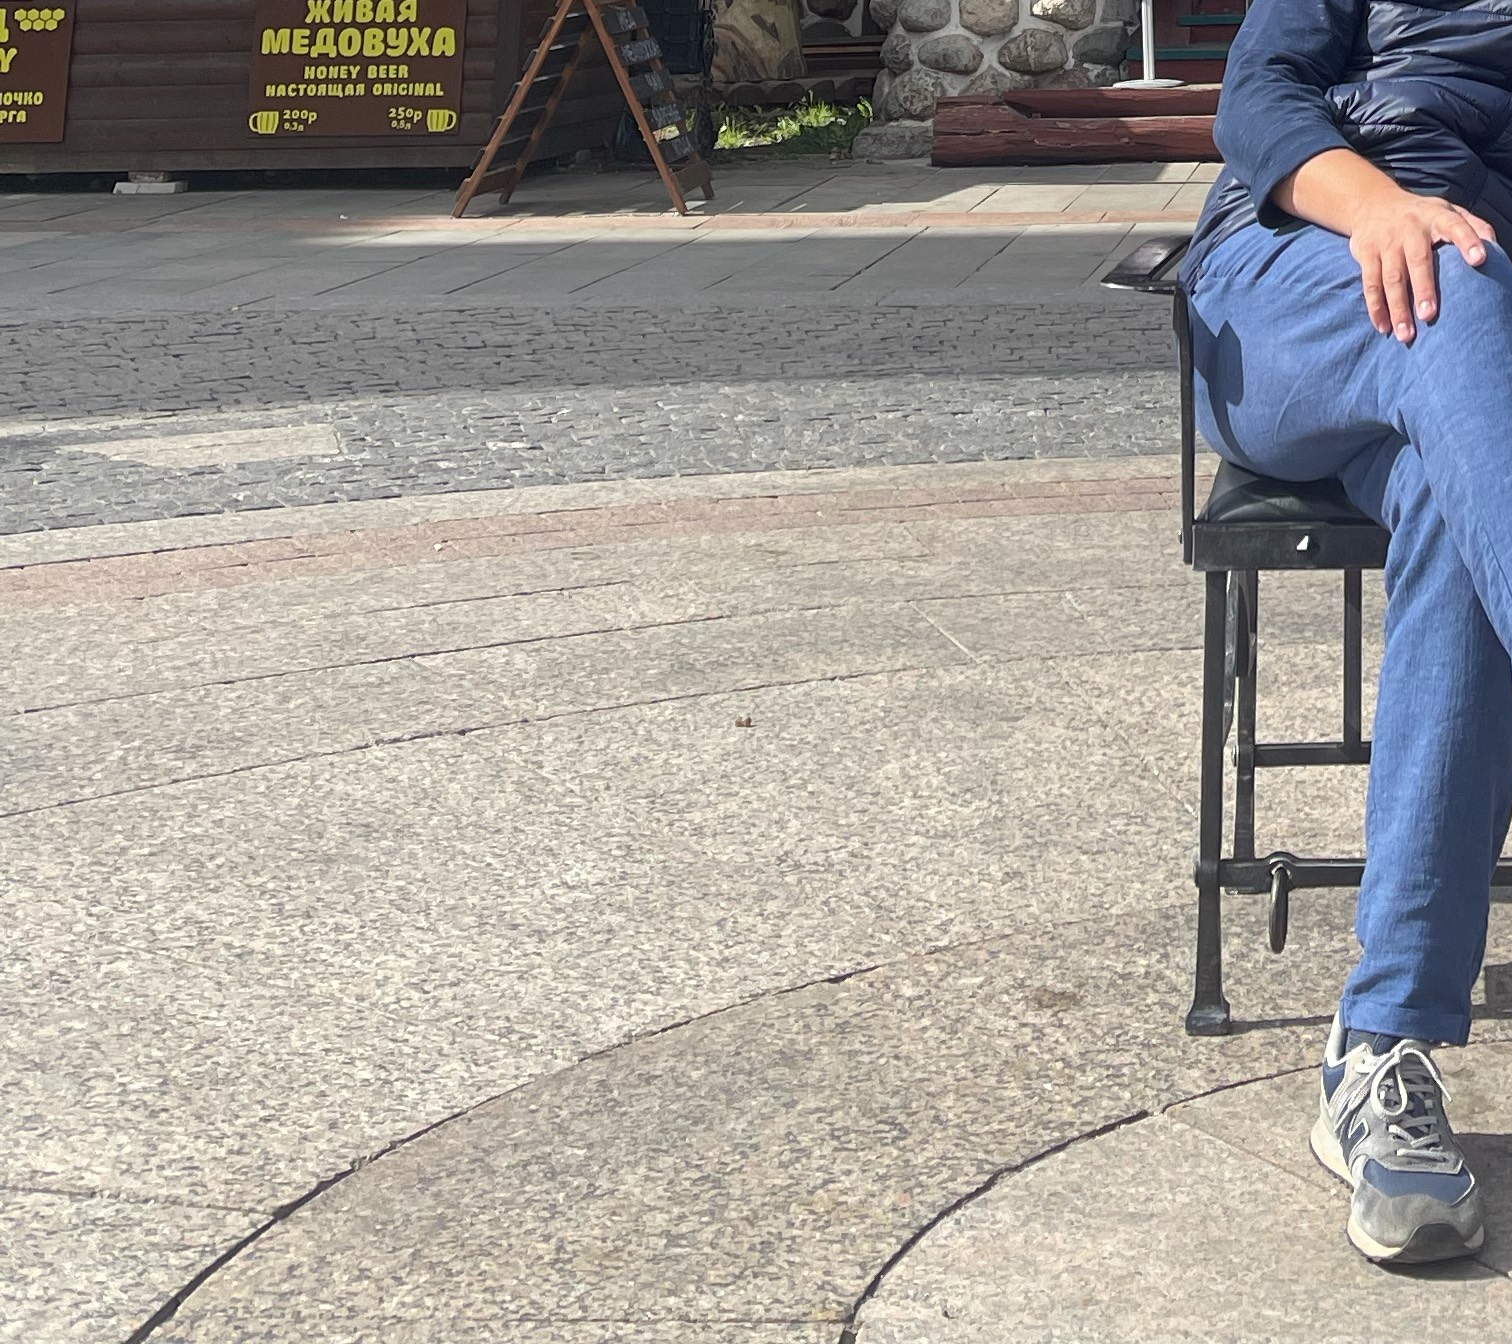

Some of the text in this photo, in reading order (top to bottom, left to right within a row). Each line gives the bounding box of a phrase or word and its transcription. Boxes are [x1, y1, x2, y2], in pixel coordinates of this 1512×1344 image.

[261, 27, 456, 58] МЕДОВУХА
[304, 64, 409, 79] HONEY BEER
[265, 82, 444, 97] НАСТОЯЩАЯ ORIGINAL
[0, 92, 43, 106] ОЧКО
